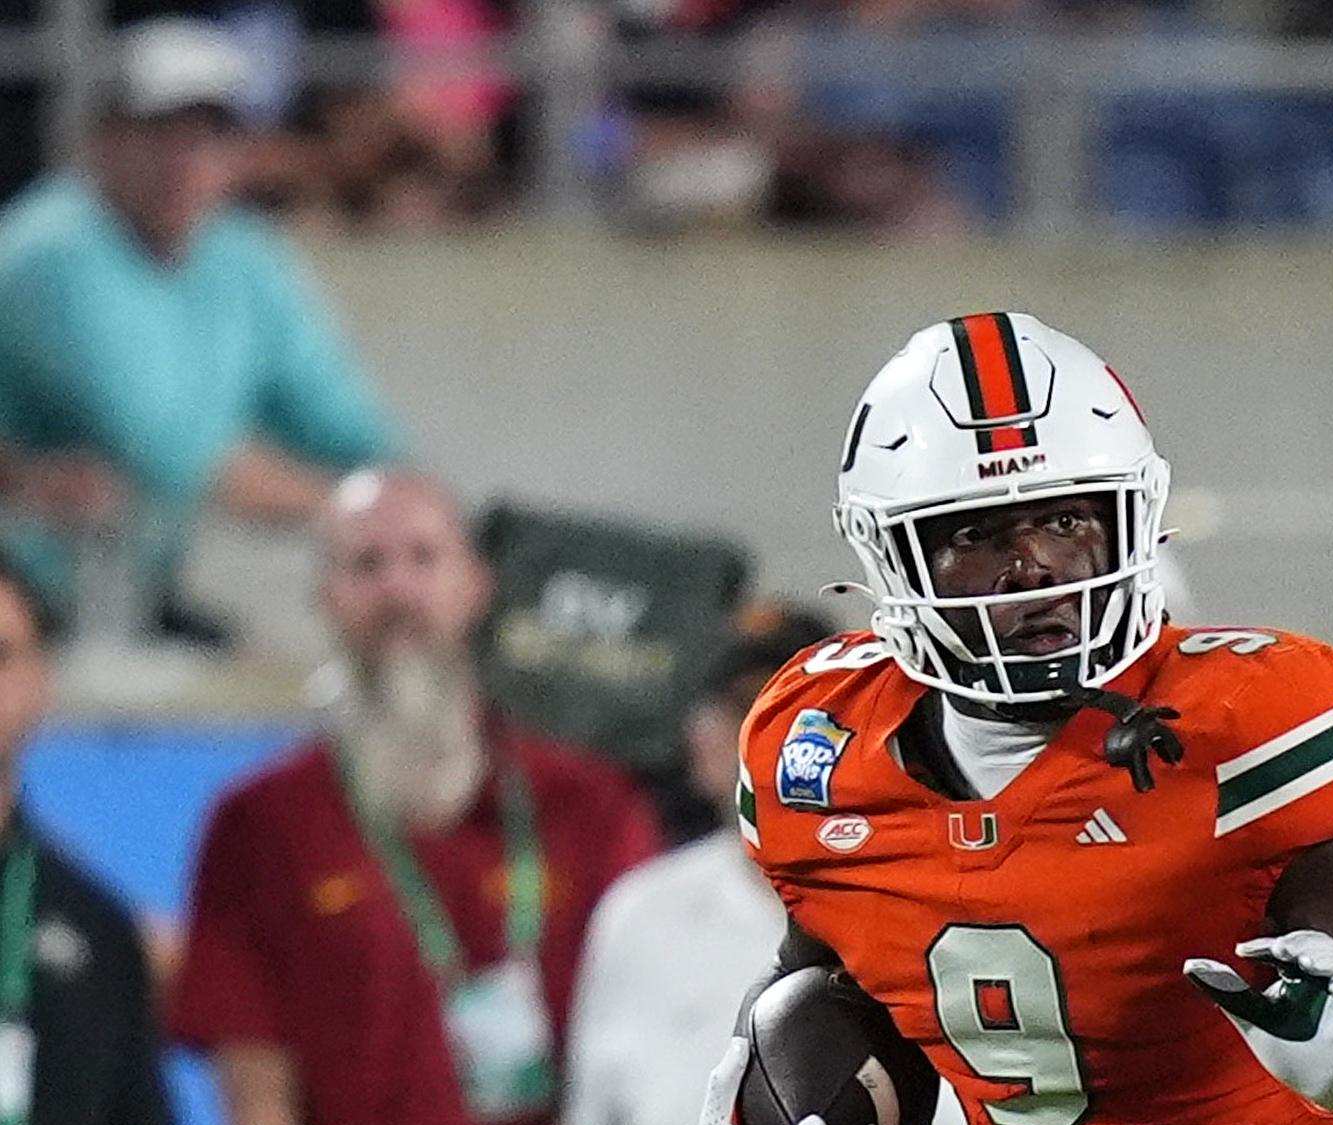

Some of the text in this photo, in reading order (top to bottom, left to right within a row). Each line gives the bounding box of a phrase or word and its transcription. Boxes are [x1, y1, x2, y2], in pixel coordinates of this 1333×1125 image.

[978, 454, 1046, 479] MIAMI
[1177, 628, 1278, 656] 9
[825, 823, 864, 839] ACC
[948, 813, 997, 851] U
